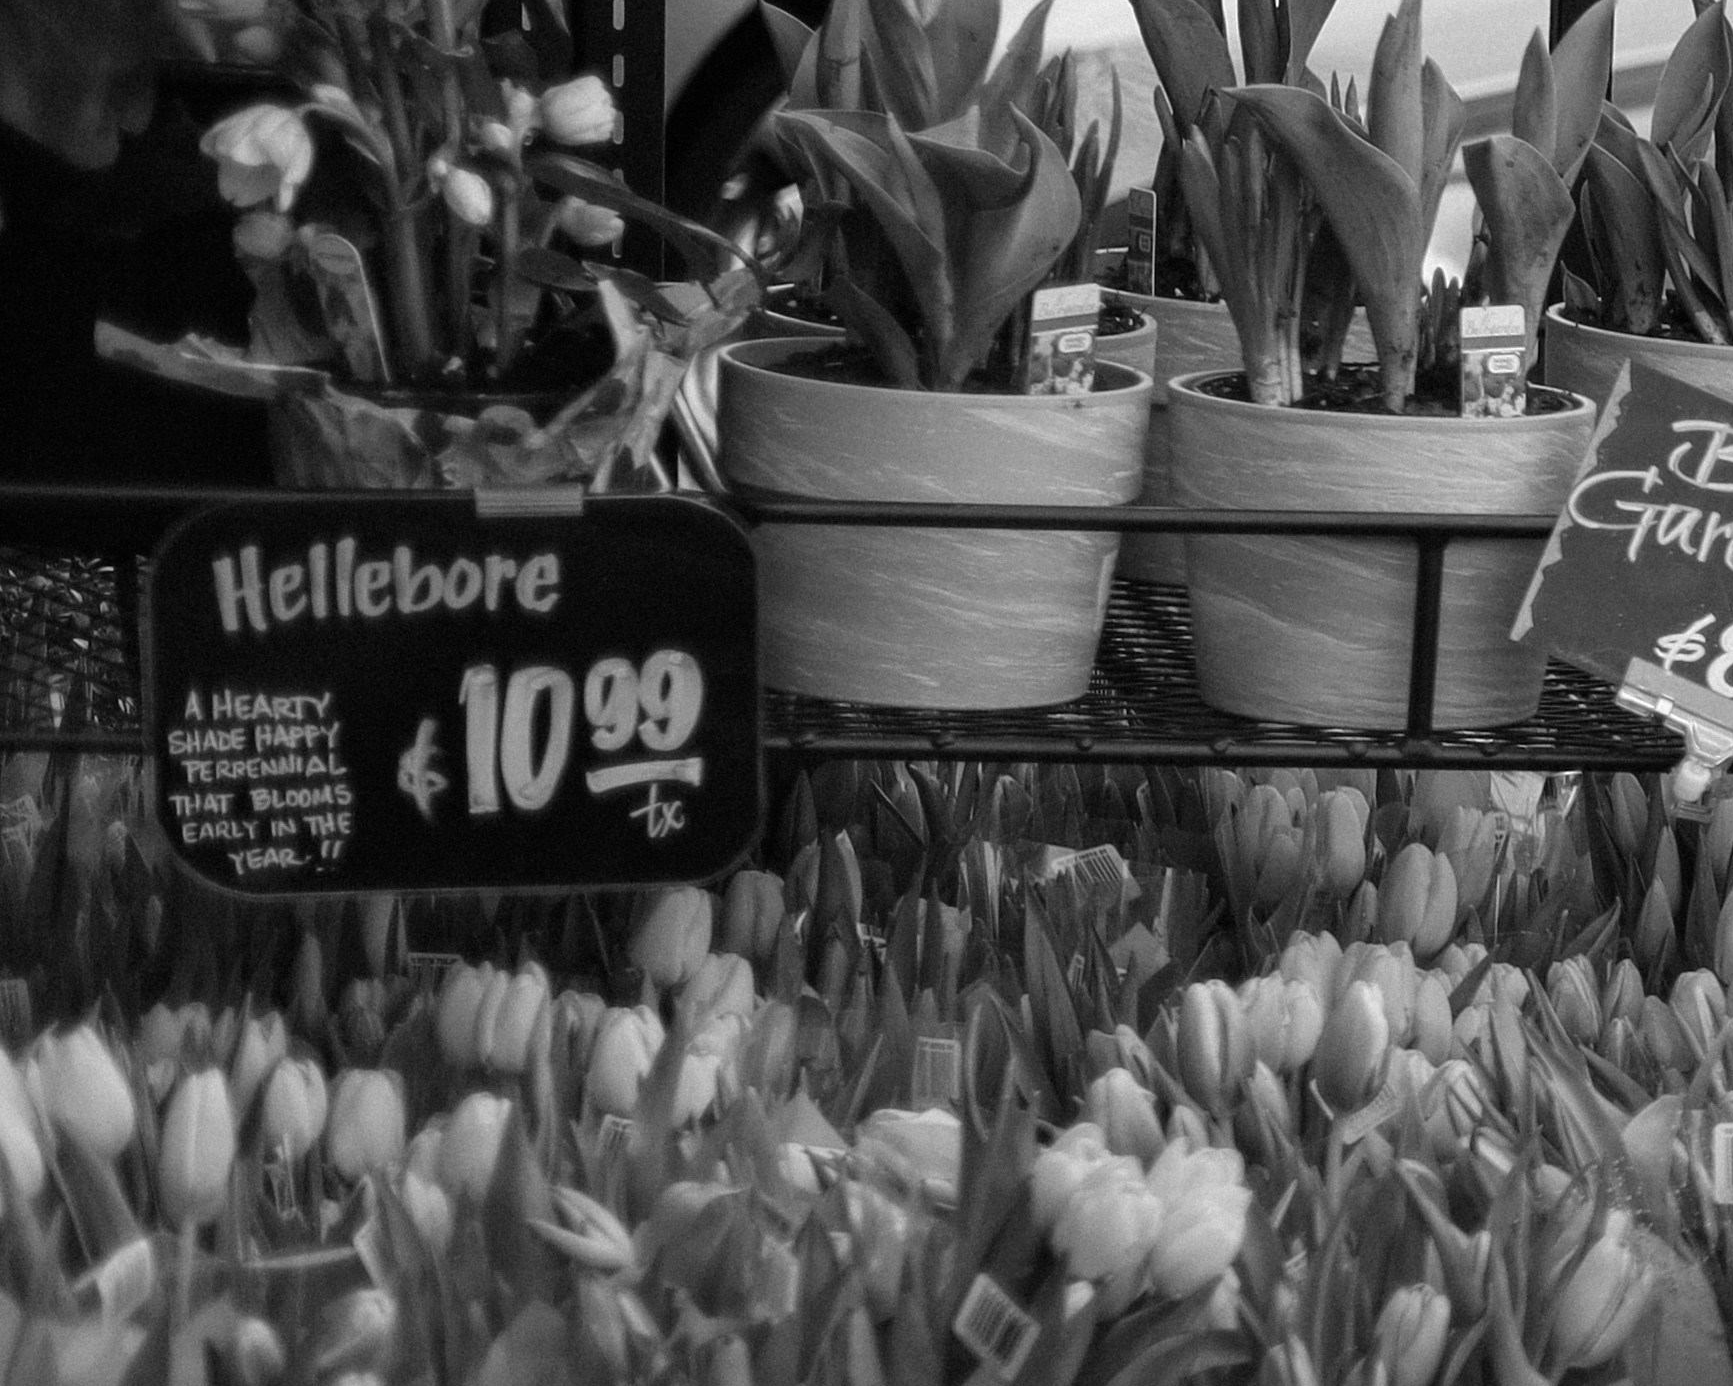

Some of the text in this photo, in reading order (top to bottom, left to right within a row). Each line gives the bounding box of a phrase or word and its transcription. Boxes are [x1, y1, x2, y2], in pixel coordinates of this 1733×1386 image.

[211, 536, 561, 633] Hellebore
[184, 688, 331, 722] A HEARTY
[167, 720, 341, 756] SHADE HAPPY
[167, 783, 353, 817] THAT BLOOMS
[182, 811, 352, 844] EARLY IN THE
